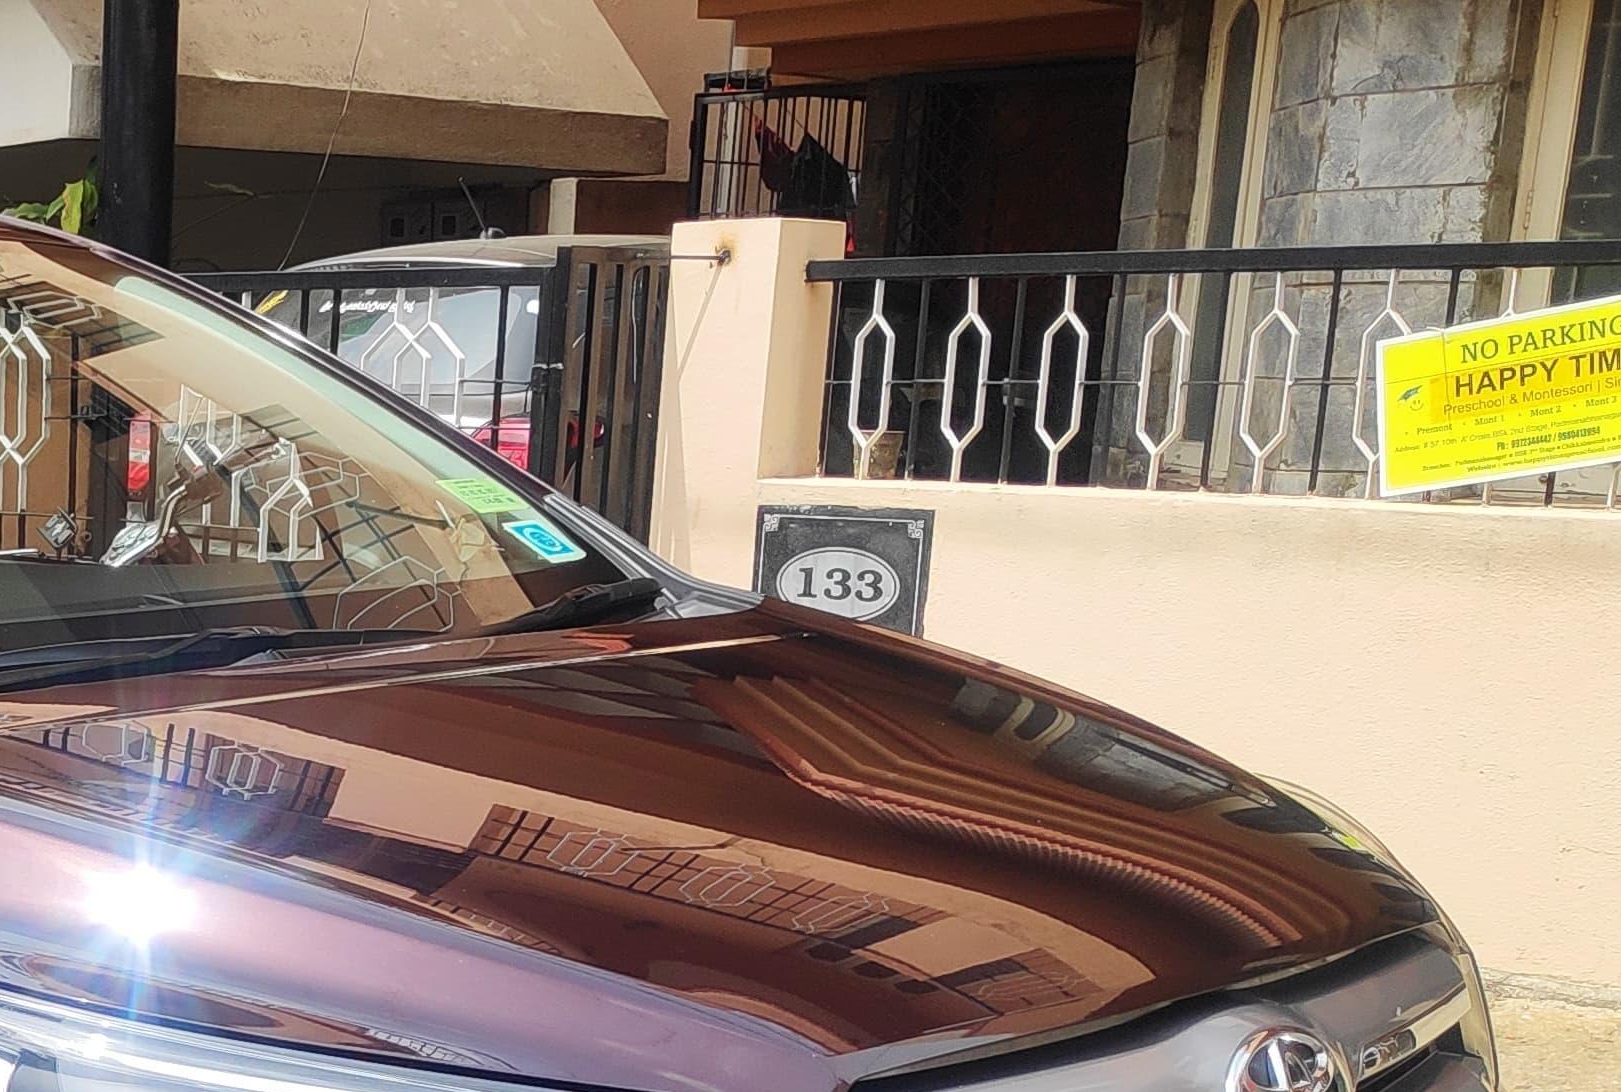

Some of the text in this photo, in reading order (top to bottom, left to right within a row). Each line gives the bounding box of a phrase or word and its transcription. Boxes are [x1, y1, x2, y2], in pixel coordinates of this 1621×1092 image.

[1460, 338, 1499, 364] NO
[1454, 357, 1559, 398] HAPPY
[1443, 395, 1505, 415] Preschool
[1509, 393, 1518, 405] &
[1522, 382, 1593, 402] Montessori
[1529, 406, 1554, 418] Mont
[1555, 405, 1562, 413] 2
[1585, 397, 1610, 408] Mont
[796, 566, 884, 602] 133
